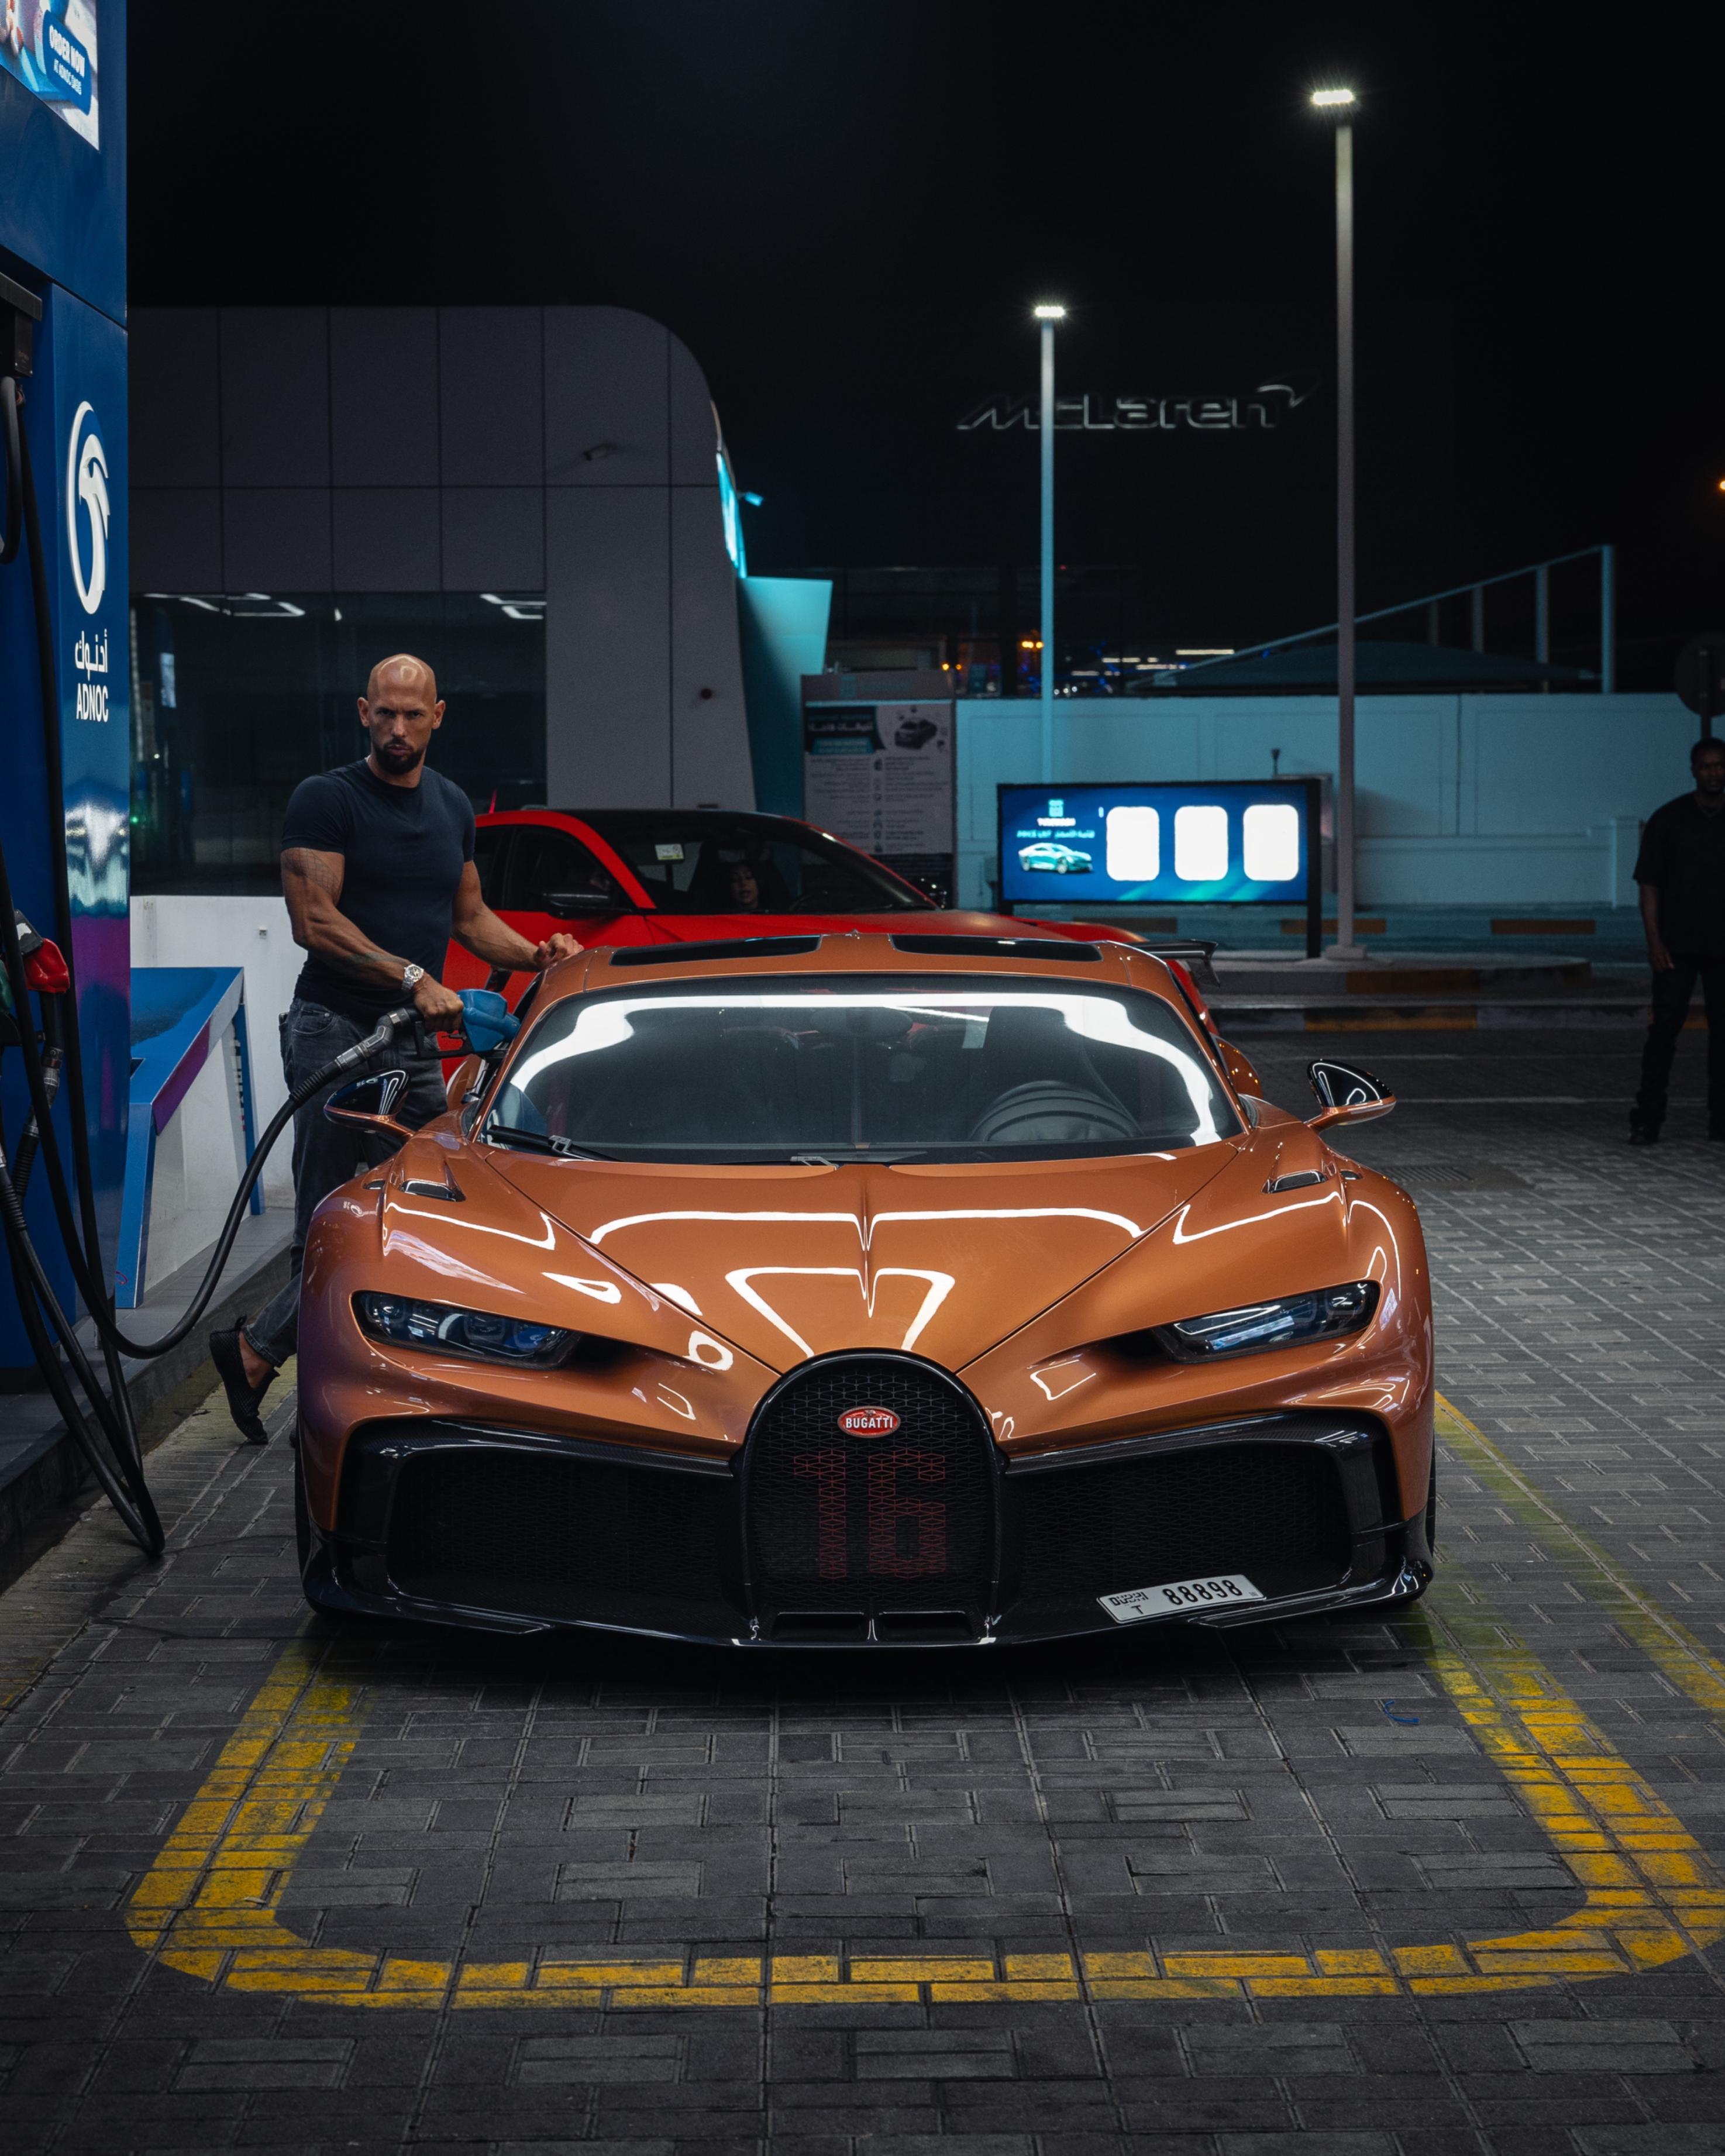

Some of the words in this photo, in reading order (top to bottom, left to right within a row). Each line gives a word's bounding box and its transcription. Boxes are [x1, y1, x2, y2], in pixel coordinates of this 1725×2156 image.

[49, 25, 70, 64] ORDER
[71, 46, 85, 78] NOW
[956, 392, 1281, 430] McLaren
[75, 628, 108, 681] أدنوك
[76, 683, 109, 722] ADNOC
[846, 1416, 893, 1428] BUGATTI
[794, 1448, 946, 1578] 16
[1131, 1604, 1144, 1614] T
[1162, 1580, 1242, 1606] 88898
